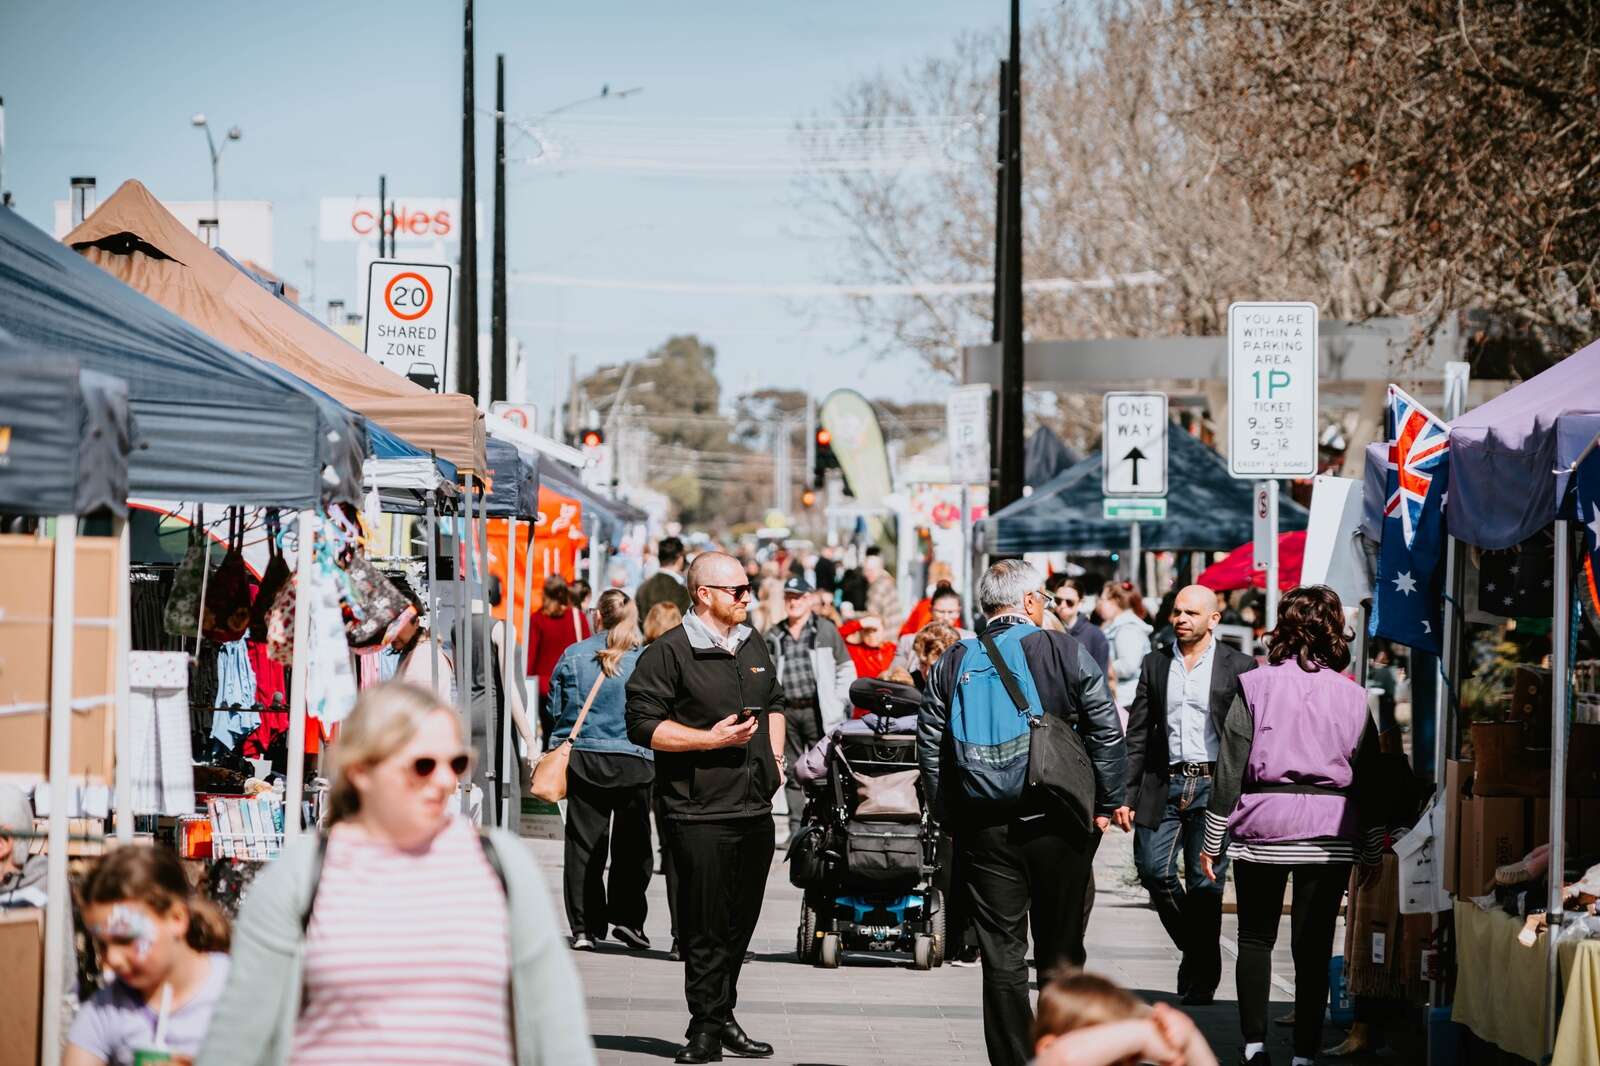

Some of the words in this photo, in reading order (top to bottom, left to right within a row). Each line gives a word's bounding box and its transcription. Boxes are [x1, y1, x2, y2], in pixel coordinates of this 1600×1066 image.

[393, 286, 425, 307] 20
[1244, 314, 1271, 325] YOU
[1277, 314, 1304, 325] ARE
[378, 325, 437, 341] SHARED
[1243, 328, 1288, 337] WITHIN
[1294, 328, 1304, 337] A
[386, 343, 426, 358] ZONE
[1243, 341, 1304, 351] PARKING
[1254, 354, 1292, 365] AREA
[1252, 371, 1291, 399] 1P
[1118, 402, 1153, 417] ONE
[1253, 401, 1292, 412] TICKET
[1118, 423, 1153, 437] WAY
